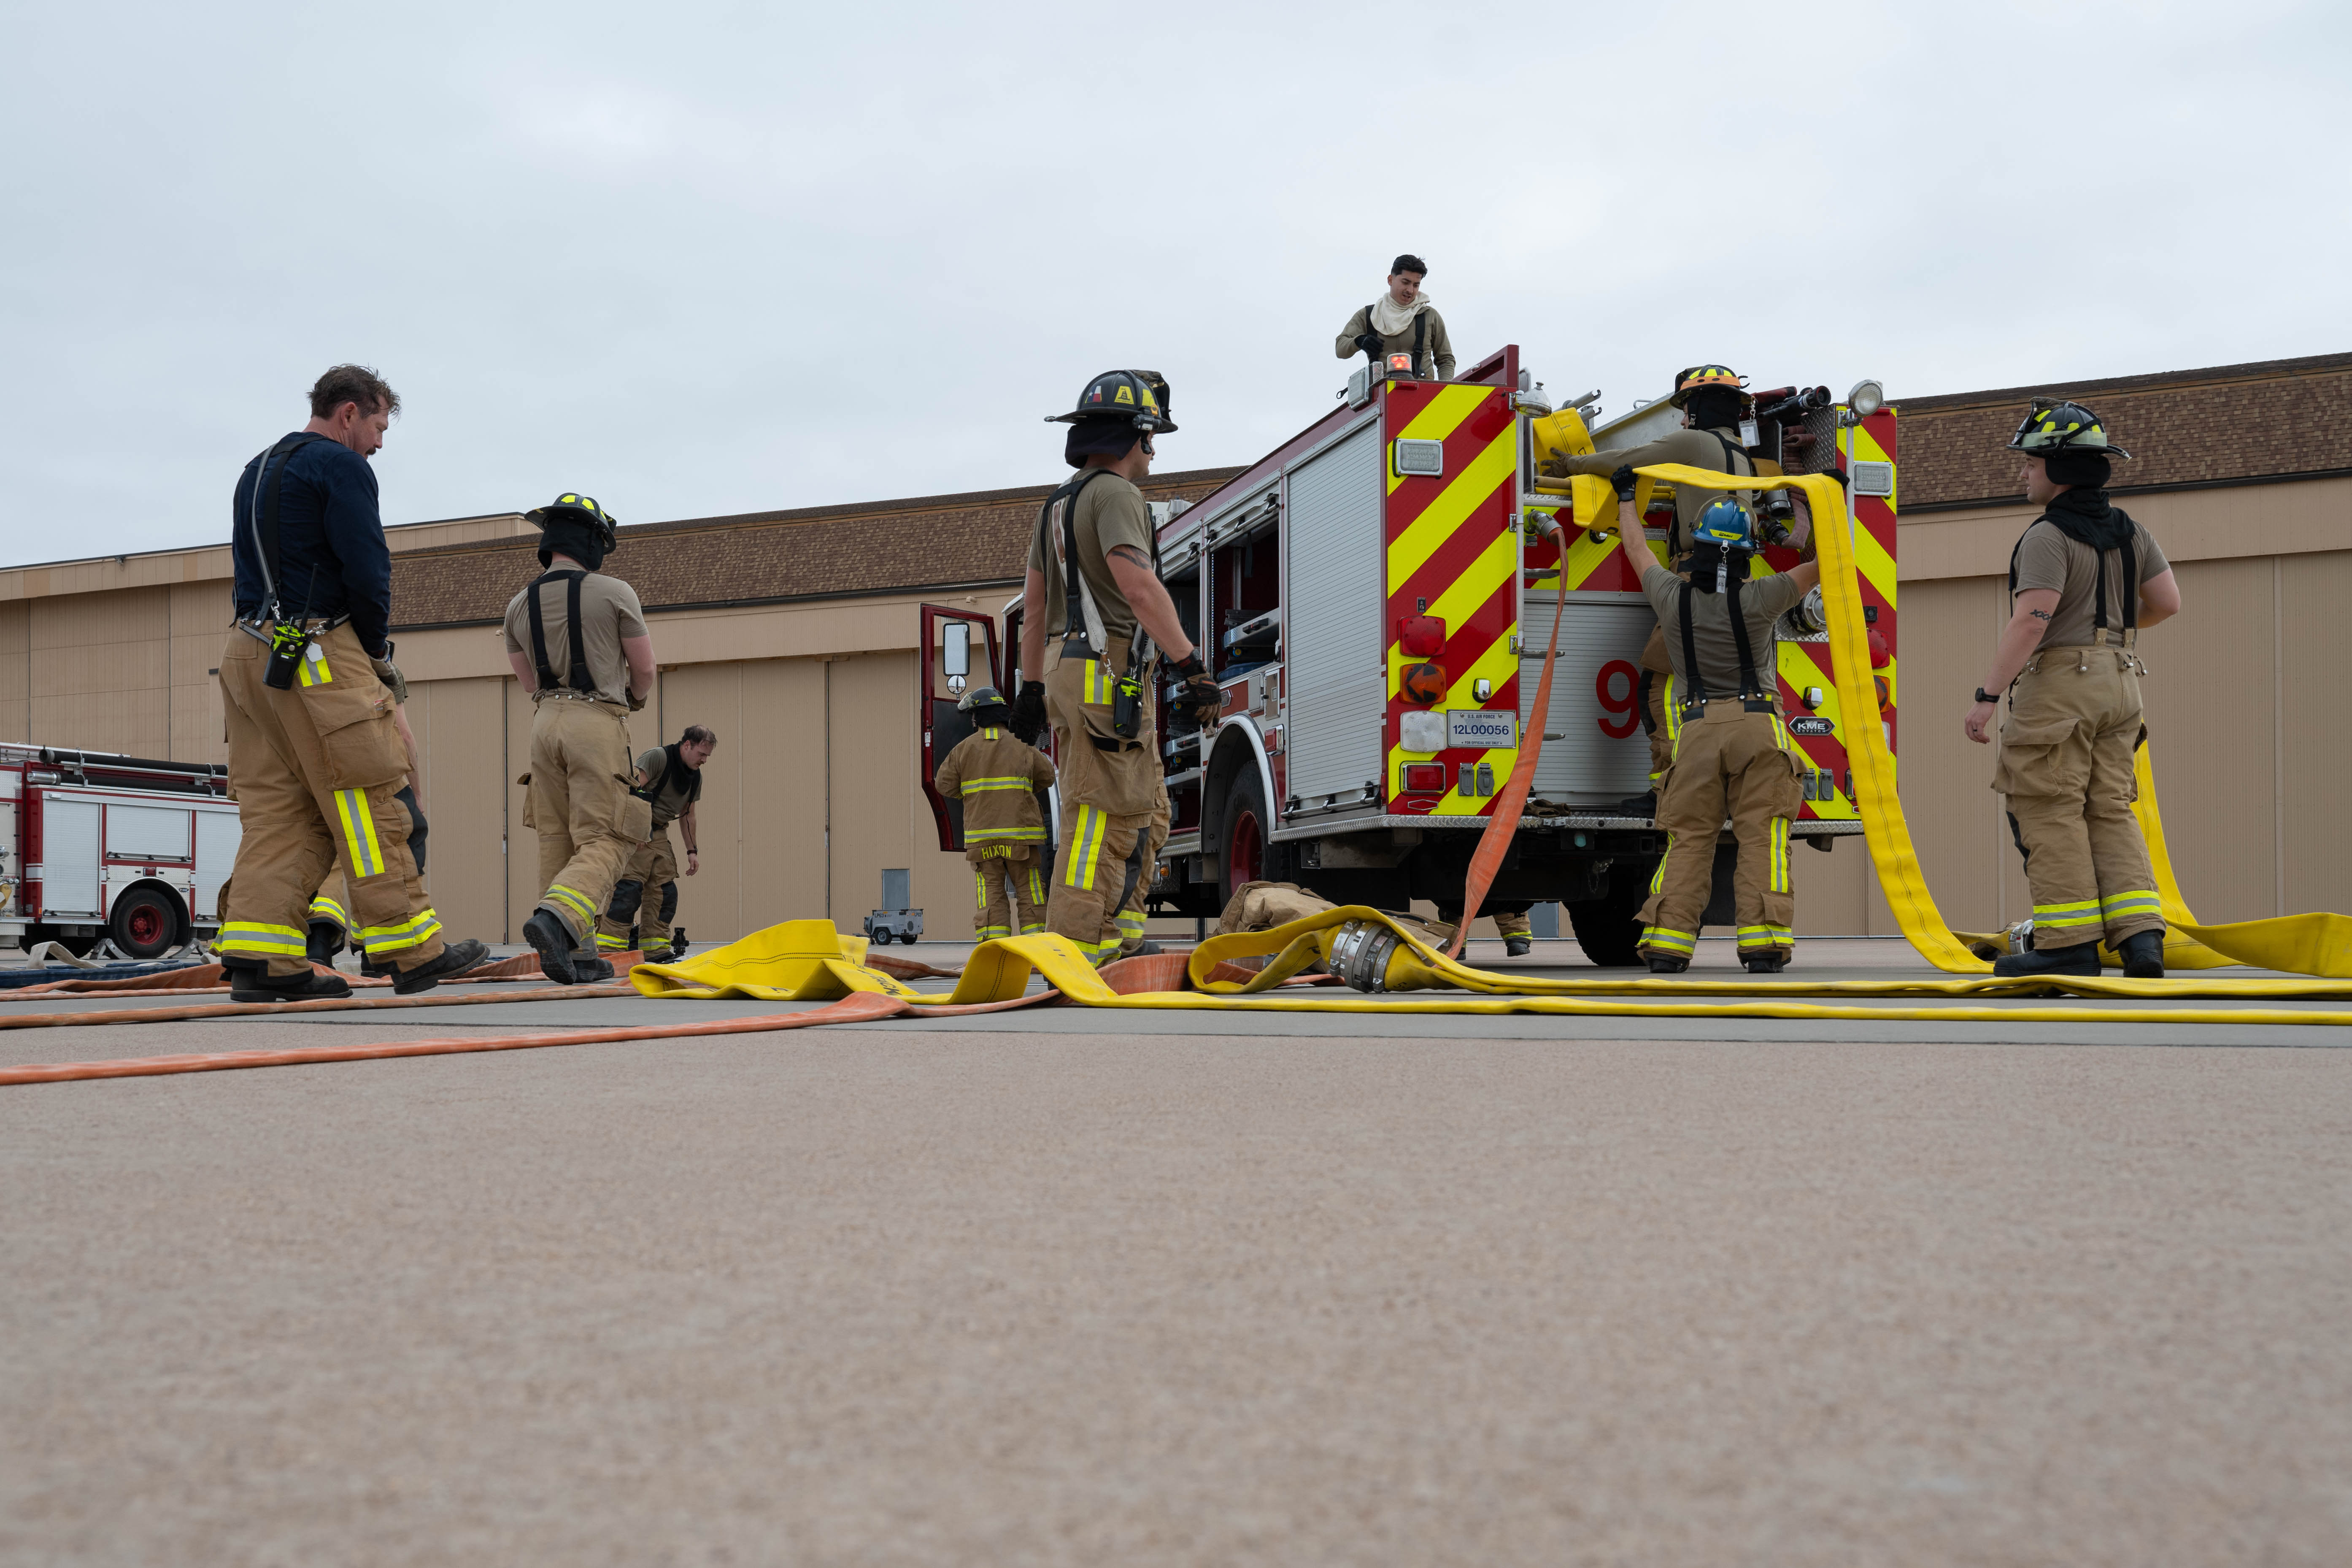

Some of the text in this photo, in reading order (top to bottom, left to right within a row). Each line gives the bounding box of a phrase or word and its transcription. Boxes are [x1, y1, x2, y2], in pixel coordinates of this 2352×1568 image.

[1596, 659, 1641, 739] 9
[1453, 725, 1509, 735] 12L00056
[982, 845, 1011, 859] HIXON
